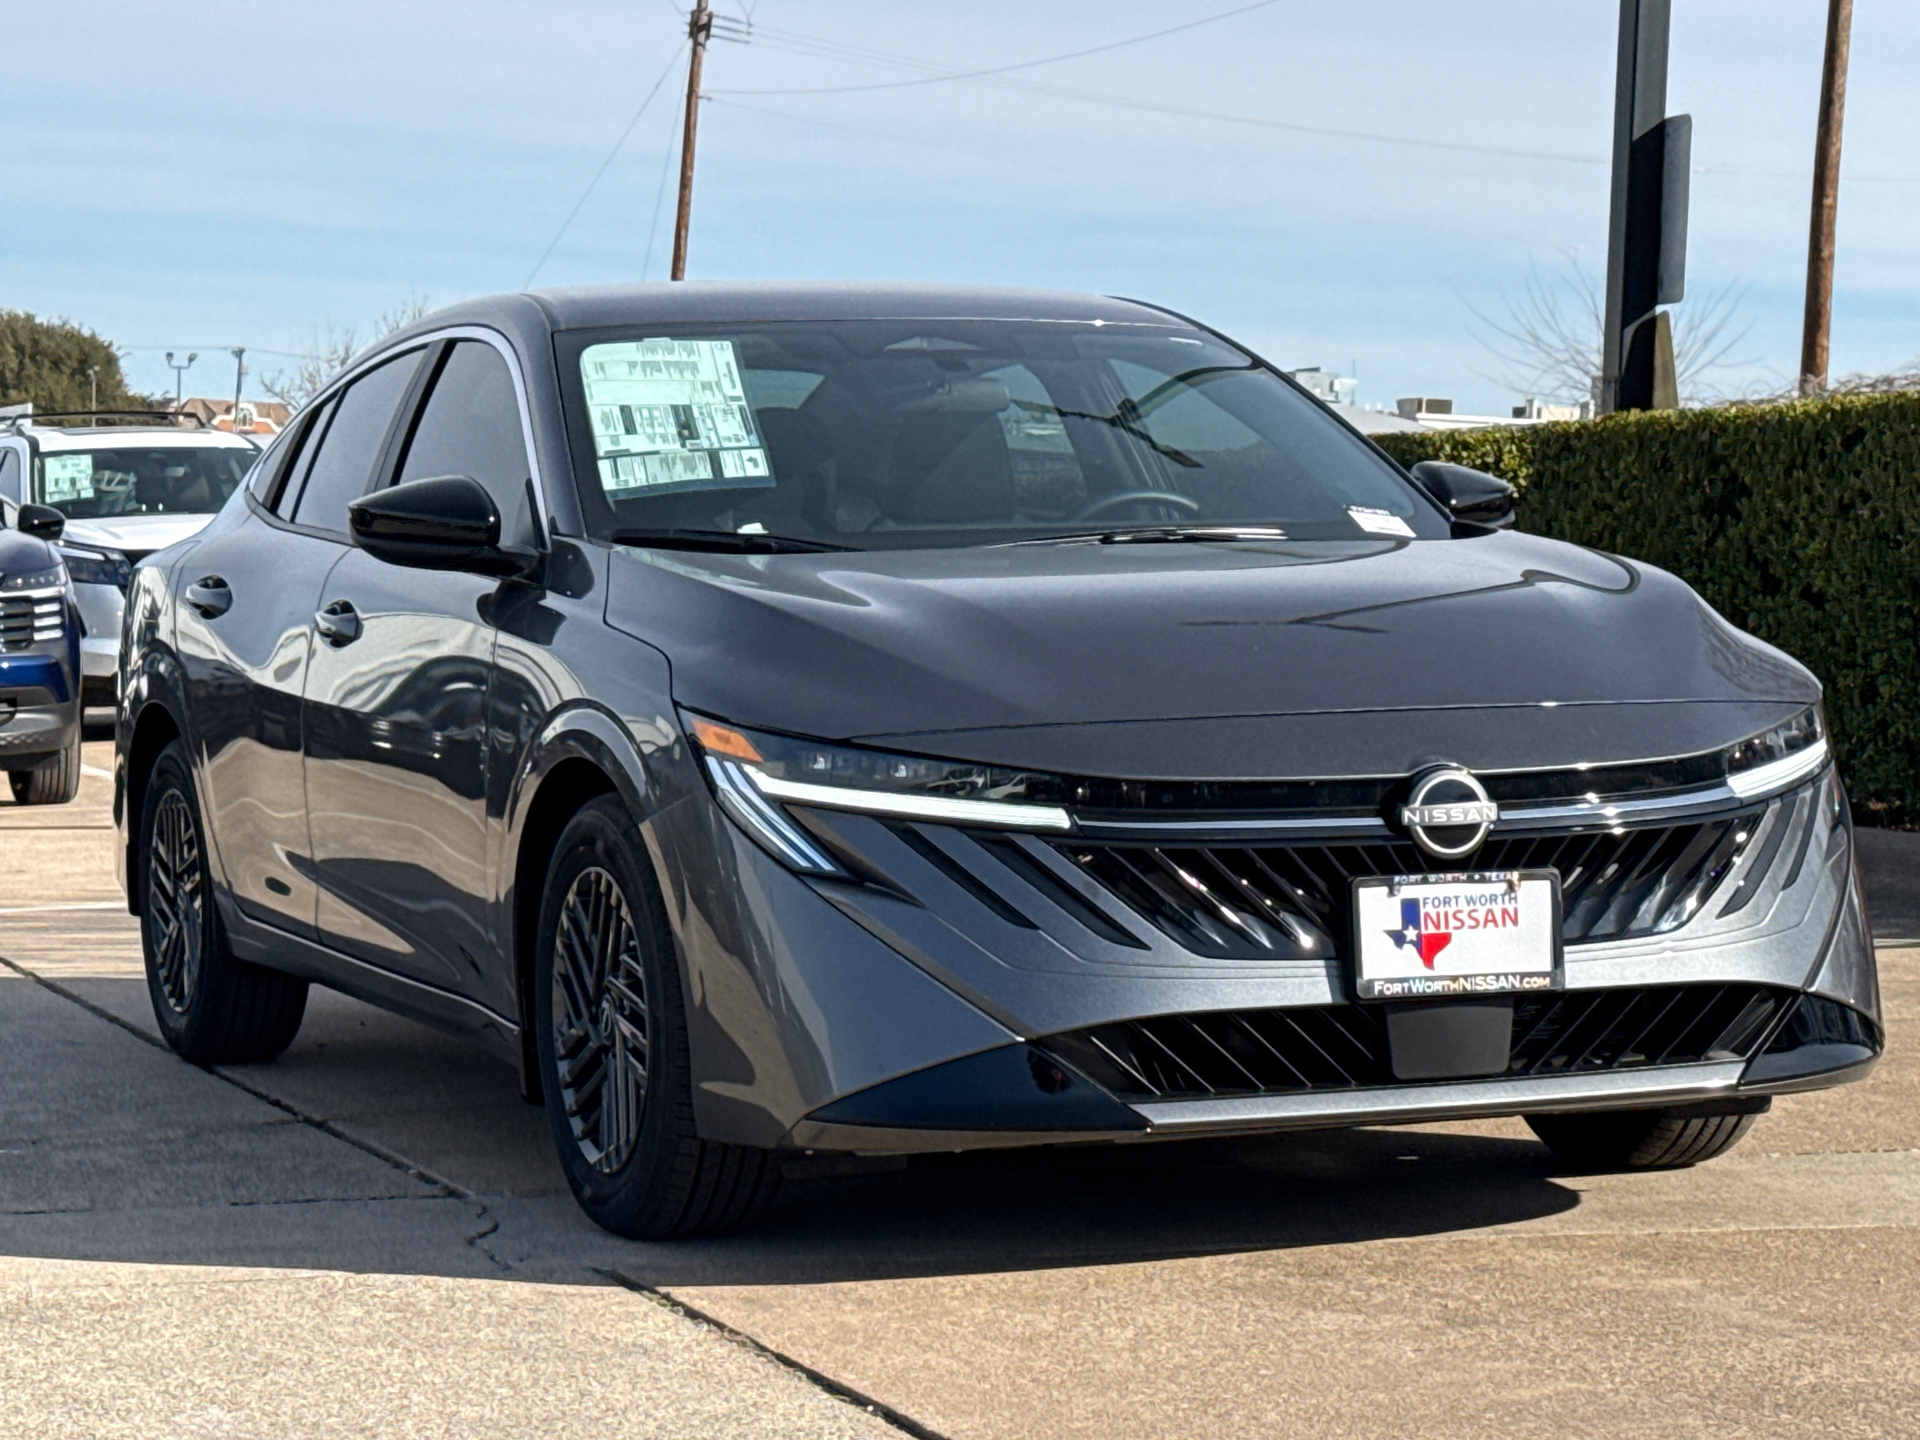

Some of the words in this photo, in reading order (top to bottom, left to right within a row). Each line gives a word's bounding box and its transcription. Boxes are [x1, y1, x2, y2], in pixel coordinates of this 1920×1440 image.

[1404, 806, 1497, 824] NISSAN
[1393, 875, 1422, 885] FORT
[1428, 873, 1467, 883] WORTH
[1485, 871, 1520, 882] TEXAS
[1423, 896, 1460, 909] FORT
[1465, 893, 1518, 907] WORTH
[1424, 907, 1519, 931] NISSAN
